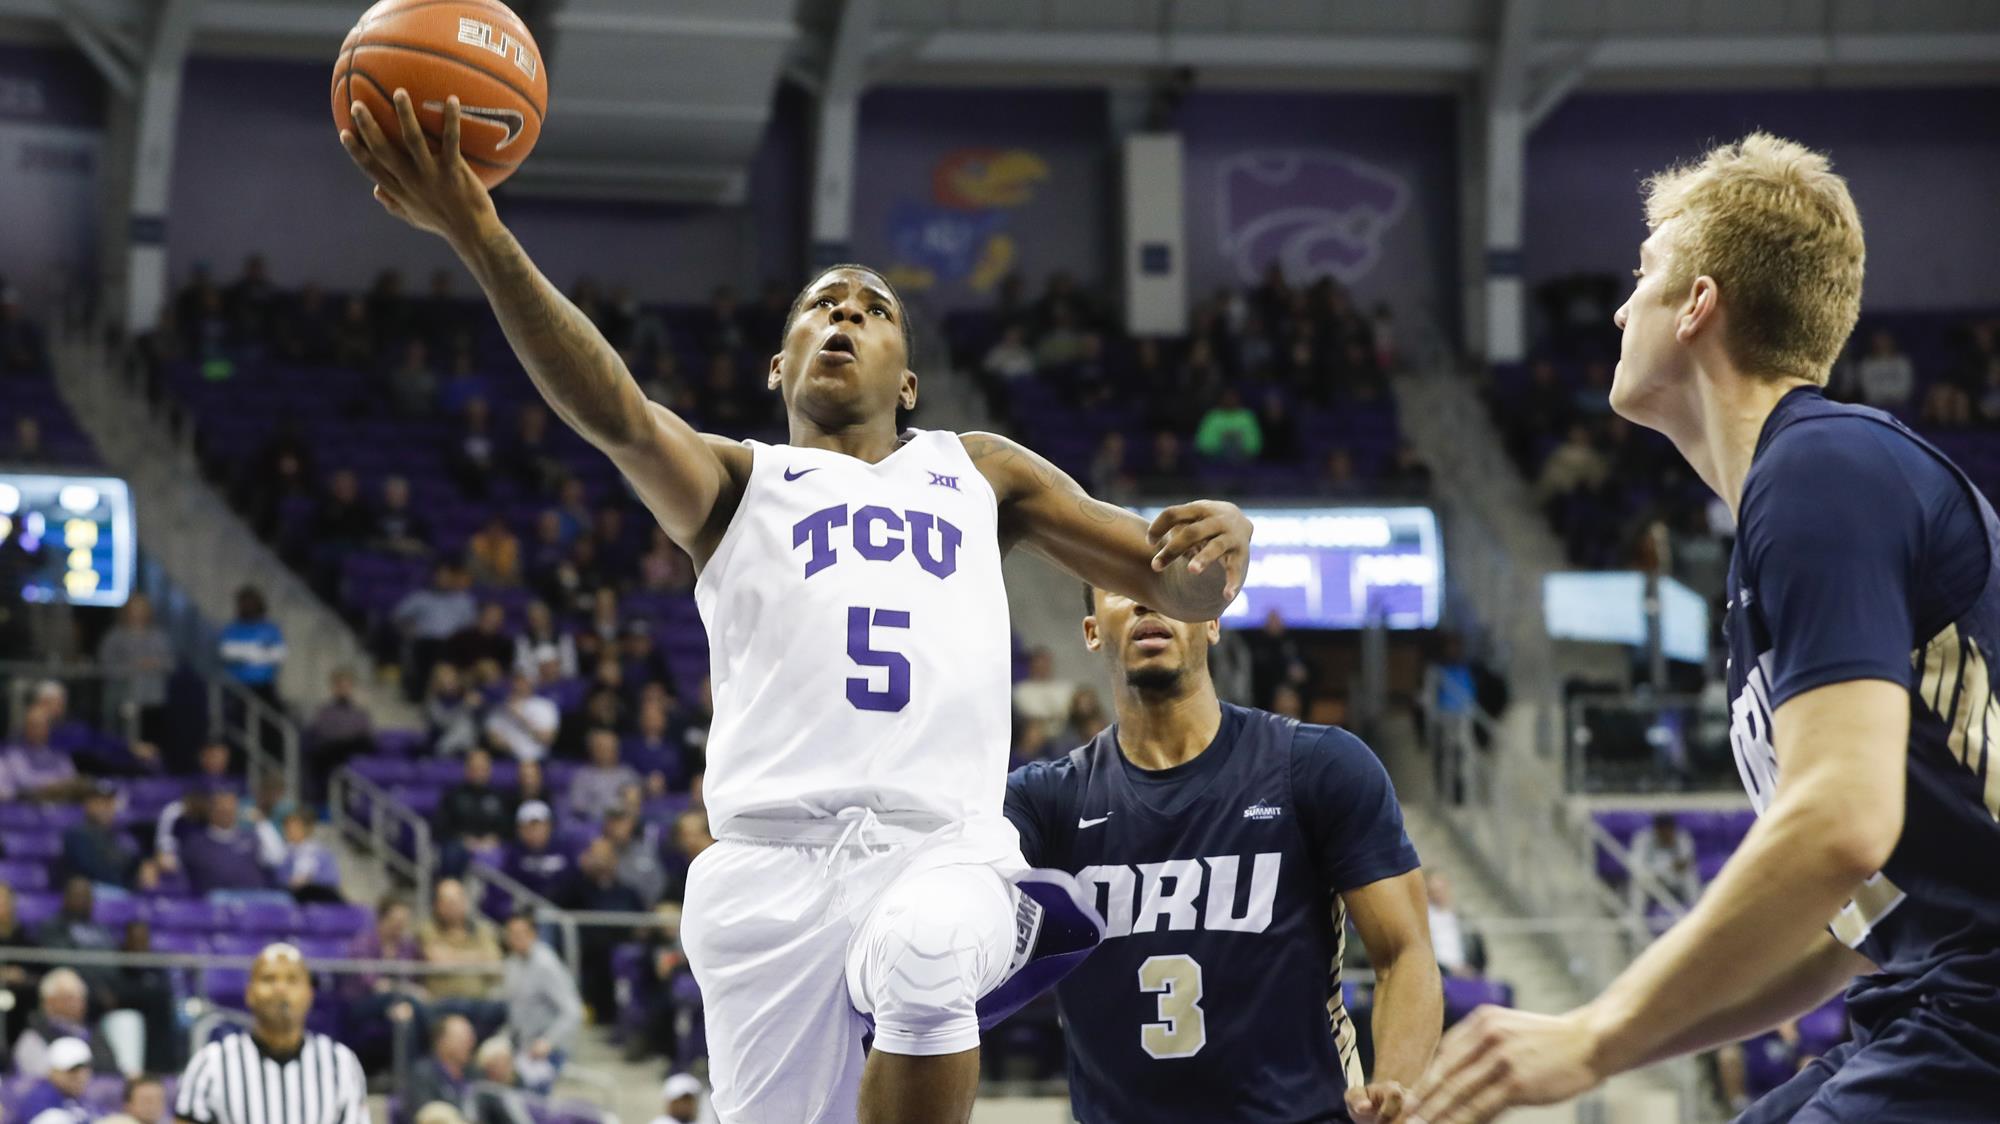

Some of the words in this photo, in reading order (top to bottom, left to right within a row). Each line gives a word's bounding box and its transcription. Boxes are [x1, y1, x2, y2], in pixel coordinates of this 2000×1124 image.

[458, 17, 537, 80] ELITE
[793, 503, 962, 580] TCU
[846, 606, 910, 713] 5
[1244, 807, 1281, 817] SUMMIT
[1074, 852, 1282, 939] ORU
[1137, 954, 1206, 1059] 3
